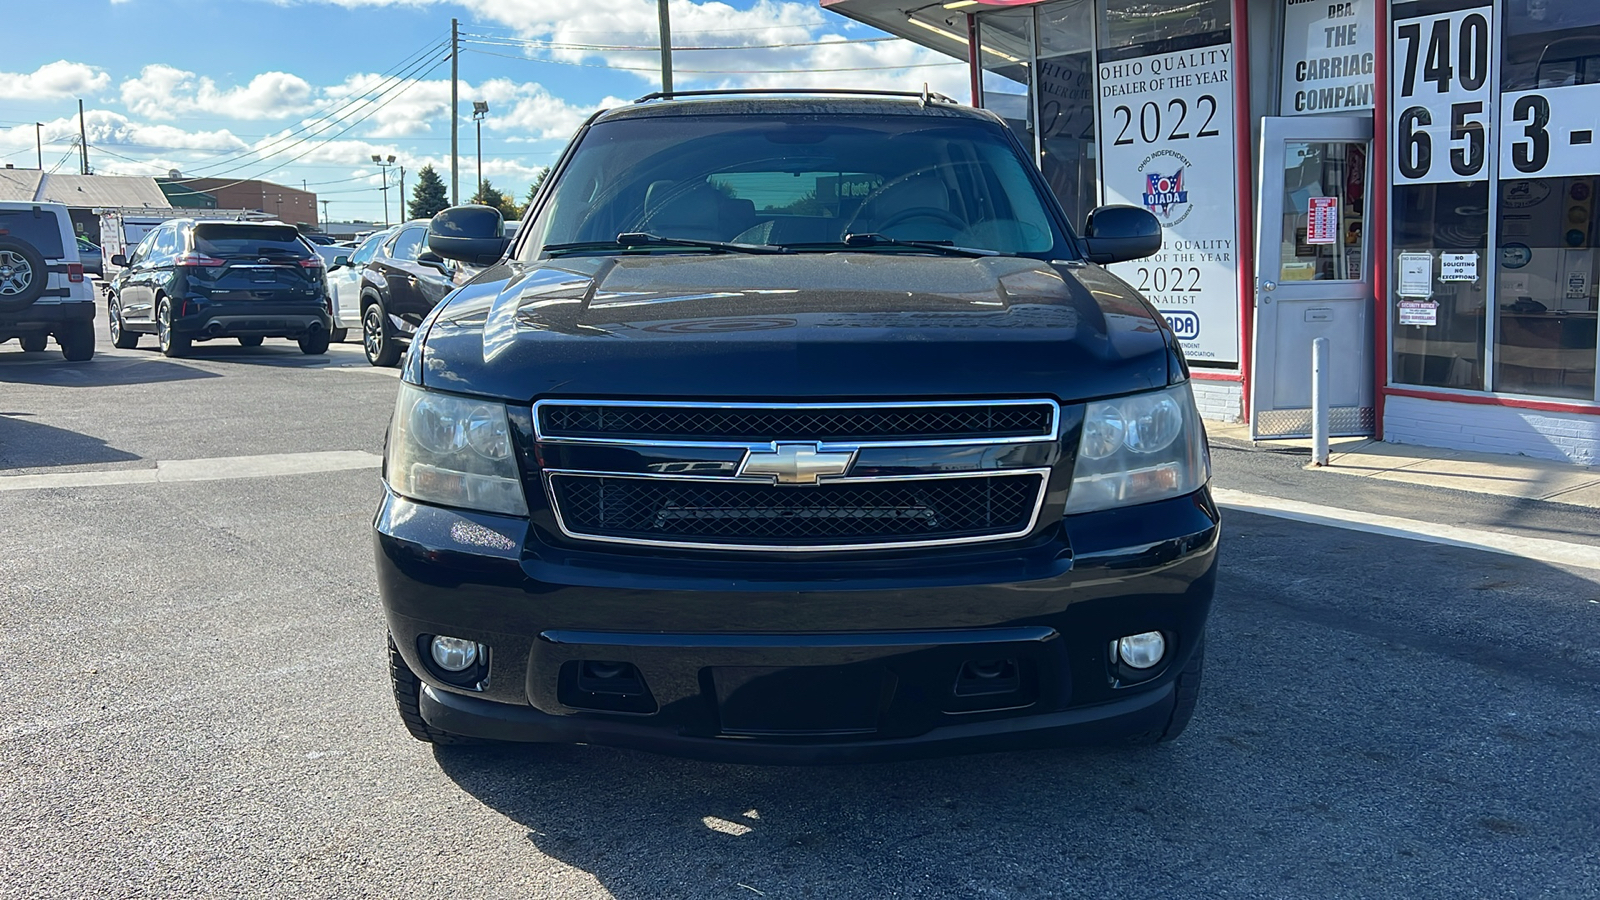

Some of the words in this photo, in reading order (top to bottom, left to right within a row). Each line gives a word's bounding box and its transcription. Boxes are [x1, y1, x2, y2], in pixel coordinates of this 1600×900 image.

[1324, 23, 1357, 48] THE
[1100, 61, 1143, 81] OHIO
[1151, 48, 1230, 75] QUALITY
[1295, 52, 1375, 82] CARRIAG
[1398, 13, 1488, 97] 740
[1041, 62, 1072, 82] HIO
[1103, 80, 1147, 98] DEALER
[1149, 78, 1165, 92] OF
[1167, 74, 1193, 89] THE
[1195, 69, 1229, 85] YEAR
[1113, 94, 1220, 146] 2022
[1137, 155, 1151, 173] OHIO
[1150, 149, 1192, 169] INDEPENDENT
[1148, 192, 1181, 205] OIADA
[1155, 254, 1168, 262] OF
[1173, 253, 1195, 262] THE
[1200, 252, 1231, 262] YEAR
[1174, 239, 1232, 252] QUALITY
[1136, 267, 1202, 292] 2022
[1145, 295, 1196, 304] INALIST
[1165, 316, 1194, 333] ADA
